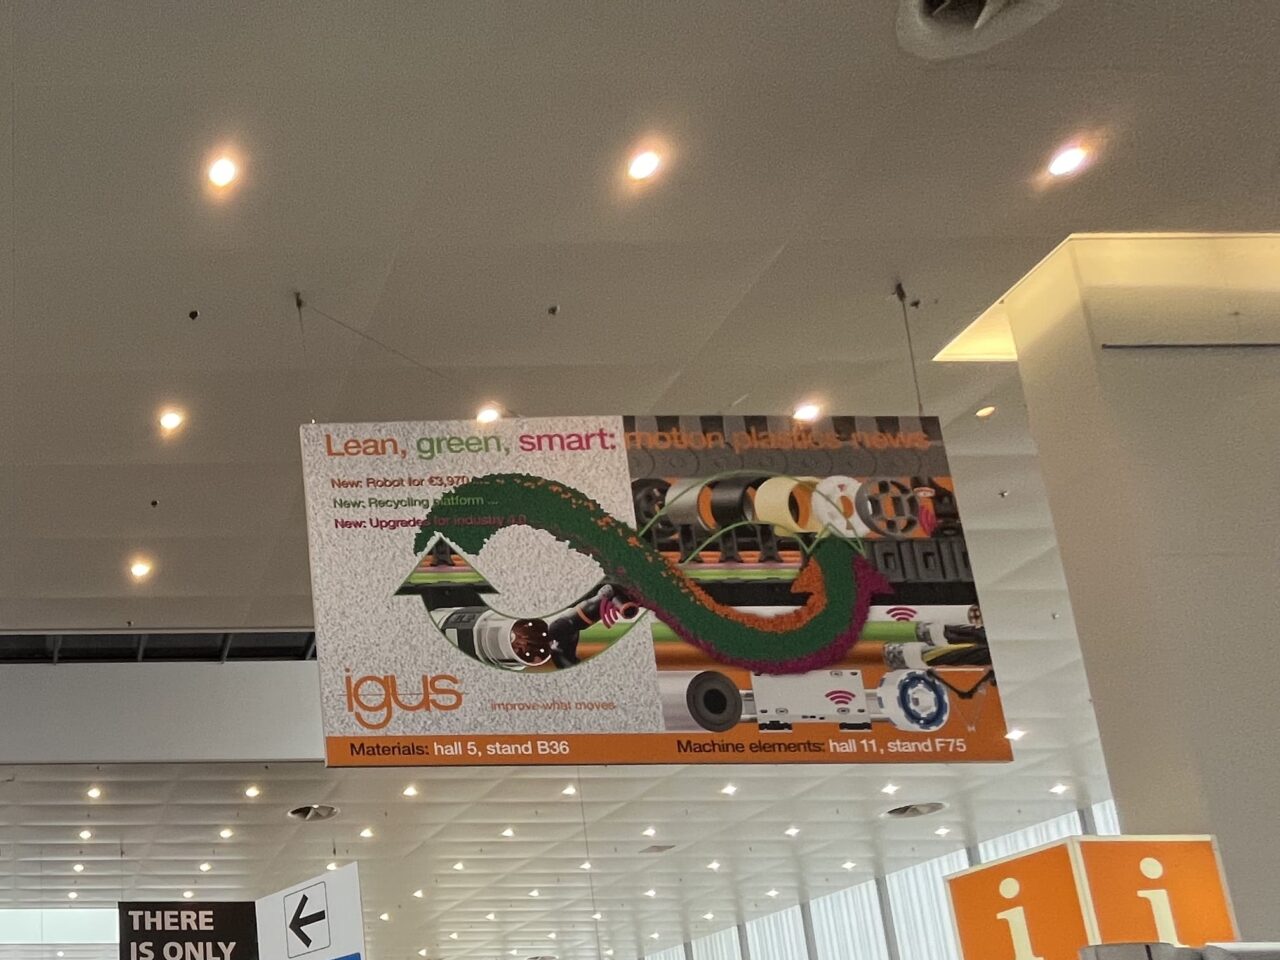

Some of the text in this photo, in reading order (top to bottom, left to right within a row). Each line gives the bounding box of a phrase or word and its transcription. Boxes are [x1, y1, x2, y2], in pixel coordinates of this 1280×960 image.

[325, 434, 407, 459] Lean,
[416, 435, 510, 460] green,
[519, 428, 617, 452] smart:
[331, 478, 362, 488] New:
[366, 477, 404, 488] Robot
[408, 477, 425, 486] for
[333, 498, 366, 508] New:
[368, 497, 429, 509] Recycling
[334, 518, 366, 528] New:
[344, 668, 463, 729] igus
[350, 740, 570, 758] Materials: hall 5, stand B36
[676, 738, 967, 755] Machine elements: hall 11, stand F75
[128, 910, 214, 931] THERE
